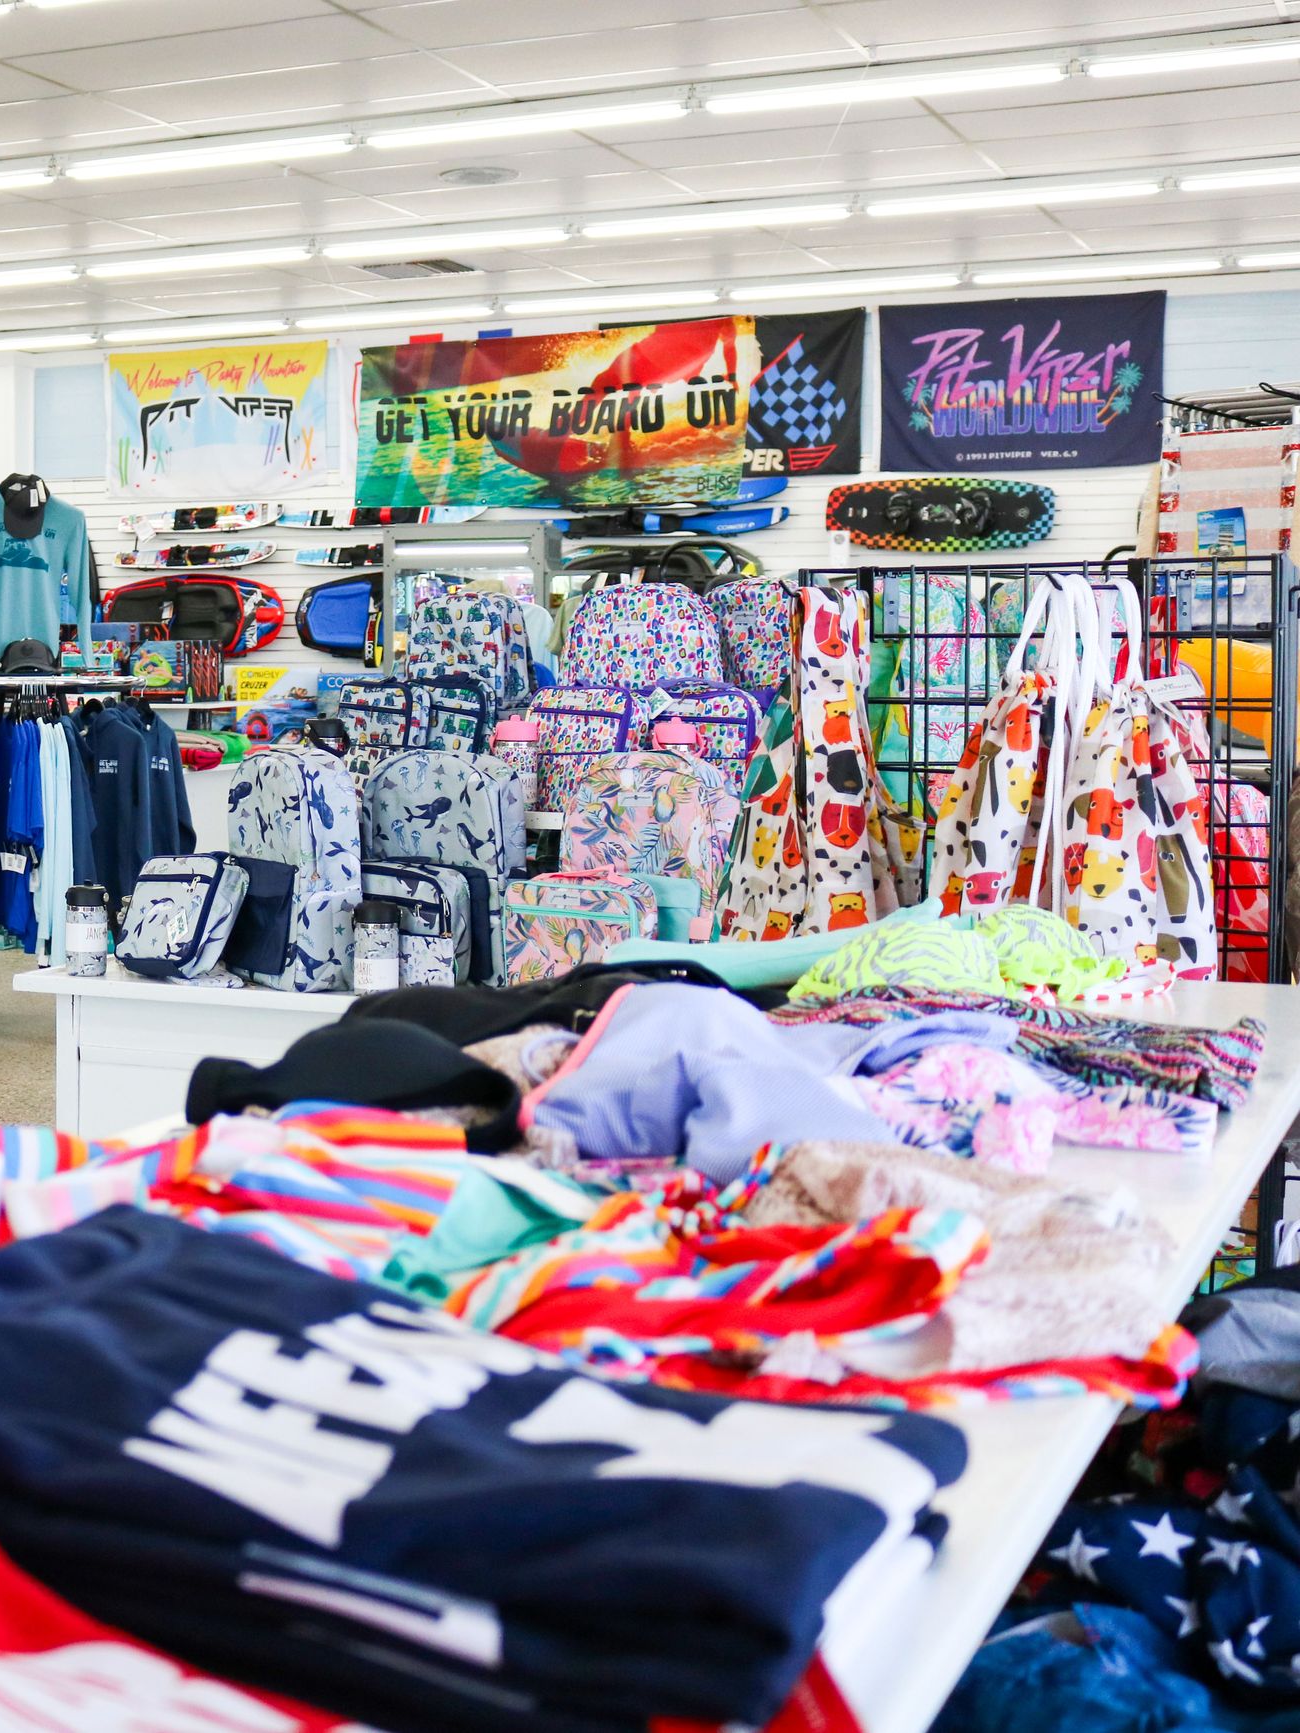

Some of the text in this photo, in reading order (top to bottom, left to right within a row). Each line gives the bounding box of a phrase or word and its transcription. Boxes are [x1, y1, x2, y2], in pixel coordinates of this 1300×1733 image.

[127, 353, 307, 397] Welcome to Party Mountain
[907, 319, 1131, 416] Pit Viper
[376, 375, 736, 443] GET YOUR BOARD ON
[931, 376, 1106, 437] WORLDWIDE
[697, 475, 734, 491] BLISS
[240, 681, 268, 689] CRUZER
